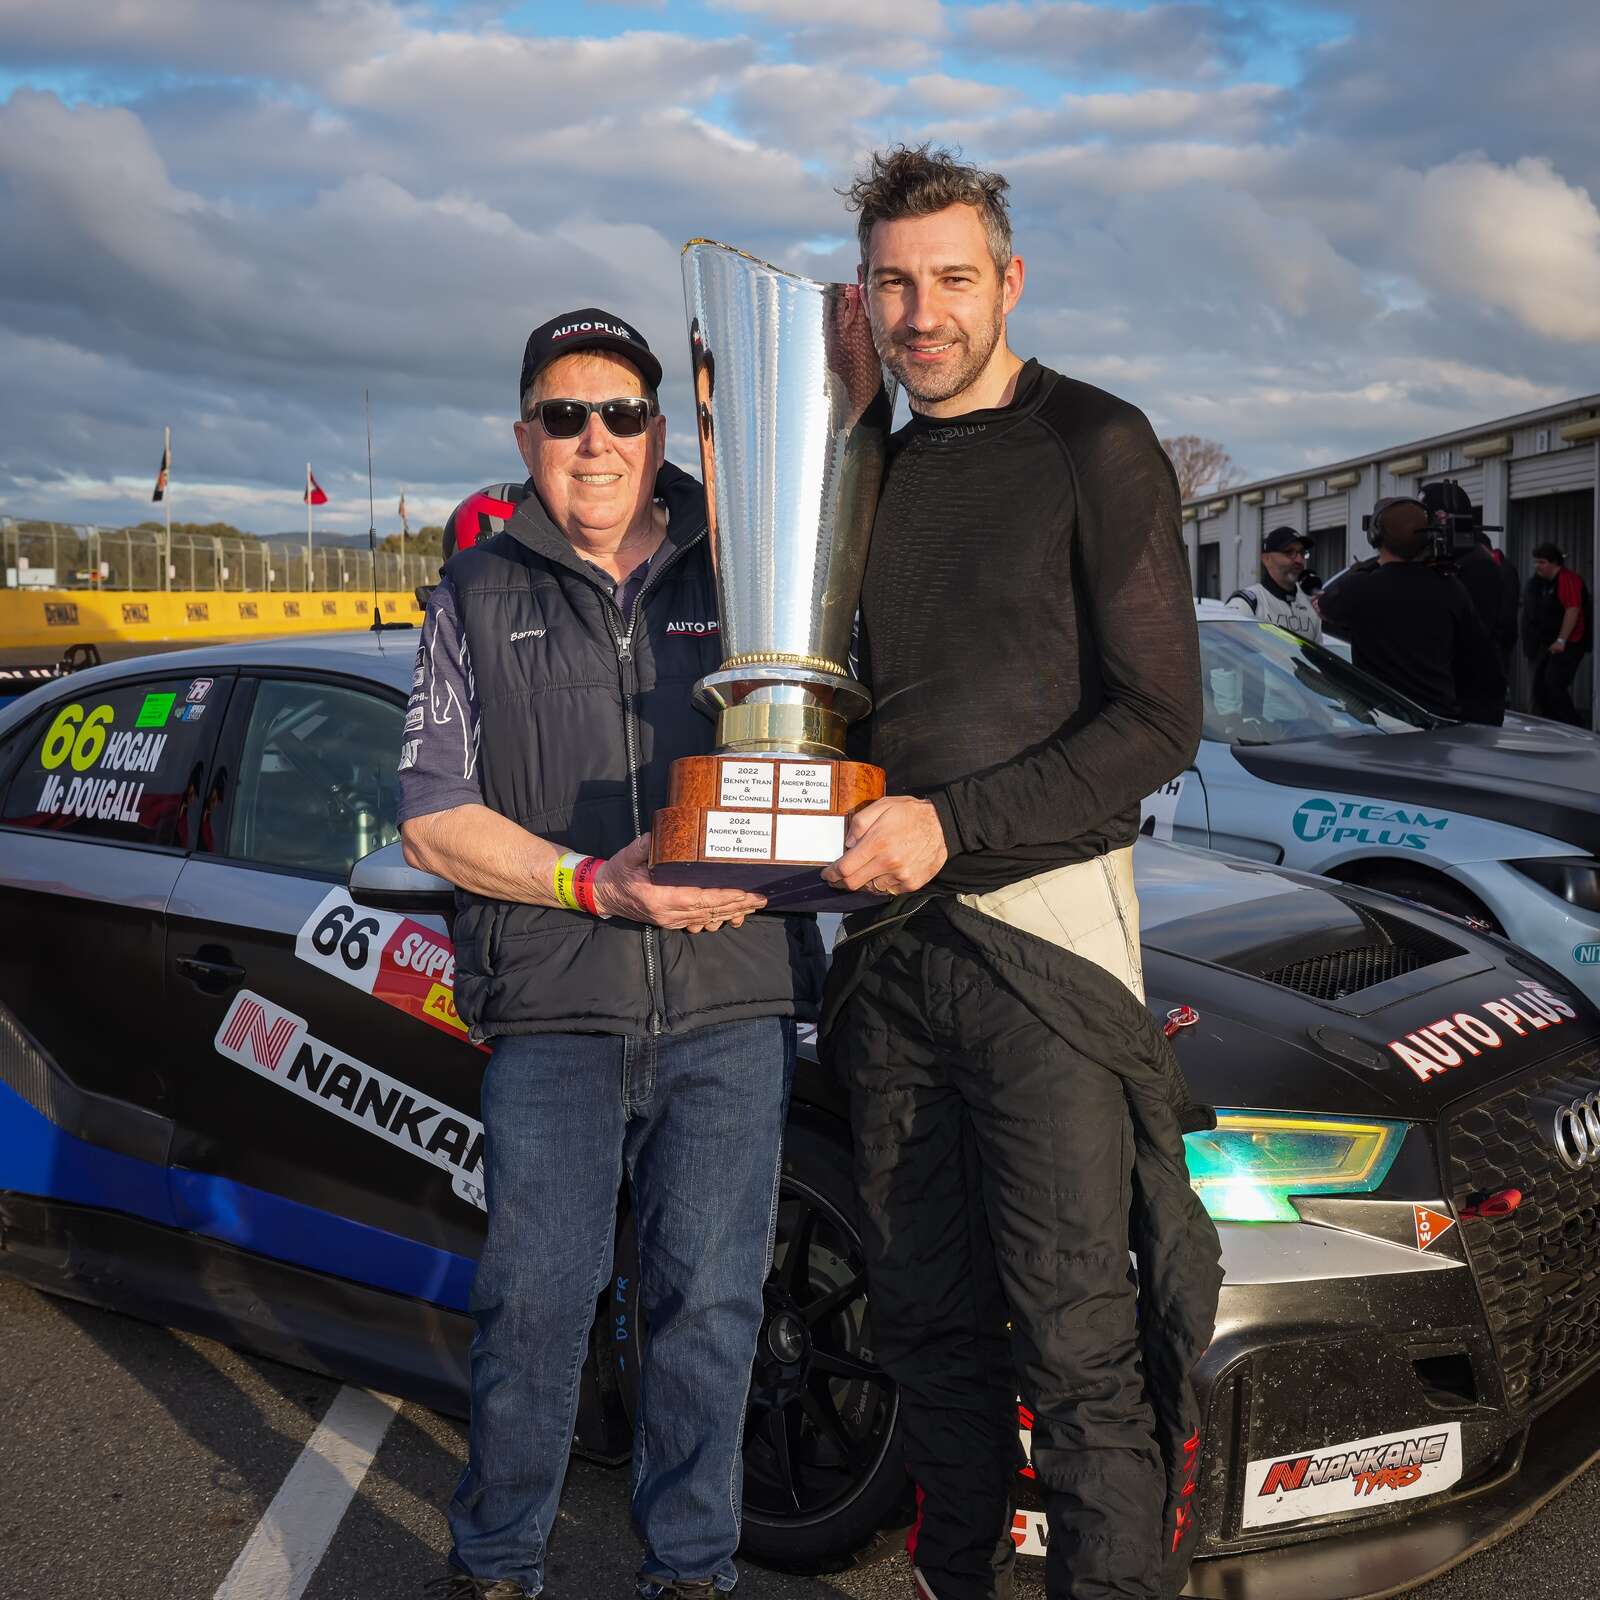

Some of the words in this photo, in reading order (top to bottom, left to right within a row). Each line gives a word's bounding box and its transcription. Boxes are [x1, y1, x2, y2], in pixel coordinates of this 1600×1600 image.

[552, 322, 592, 339] AUTO
[594, 322, 631, 339] PLUS
[510, 628, 547, 642] Barney
[666, 621, 705, 633] AUTO
[41, 703, 115, 772] 66
[100, 731, 168, 773] HOGAN
[738, 767, 759, 775] 2022
[795, 769, 816, 777] 2023
[36, 775, 64, 815] Mc
[61, 777, 144, 823] DOUGALL
[729, 817, 751, 825] 2024
[1339, 802, 1449, 831] TEAM
[1332, 827, 1431, 850] PLUS
[311, 904, 380, 971] 66
[1387, 1012, 1502, 1083] AUTO
[1482, 986, 1578, 1037] PLUS
[1418, 1211, 1432, 1242] TOW
[1303, 1432, 1449, 1486] NANKANG
[1352, 1463, 1423, 1497] TYRES
